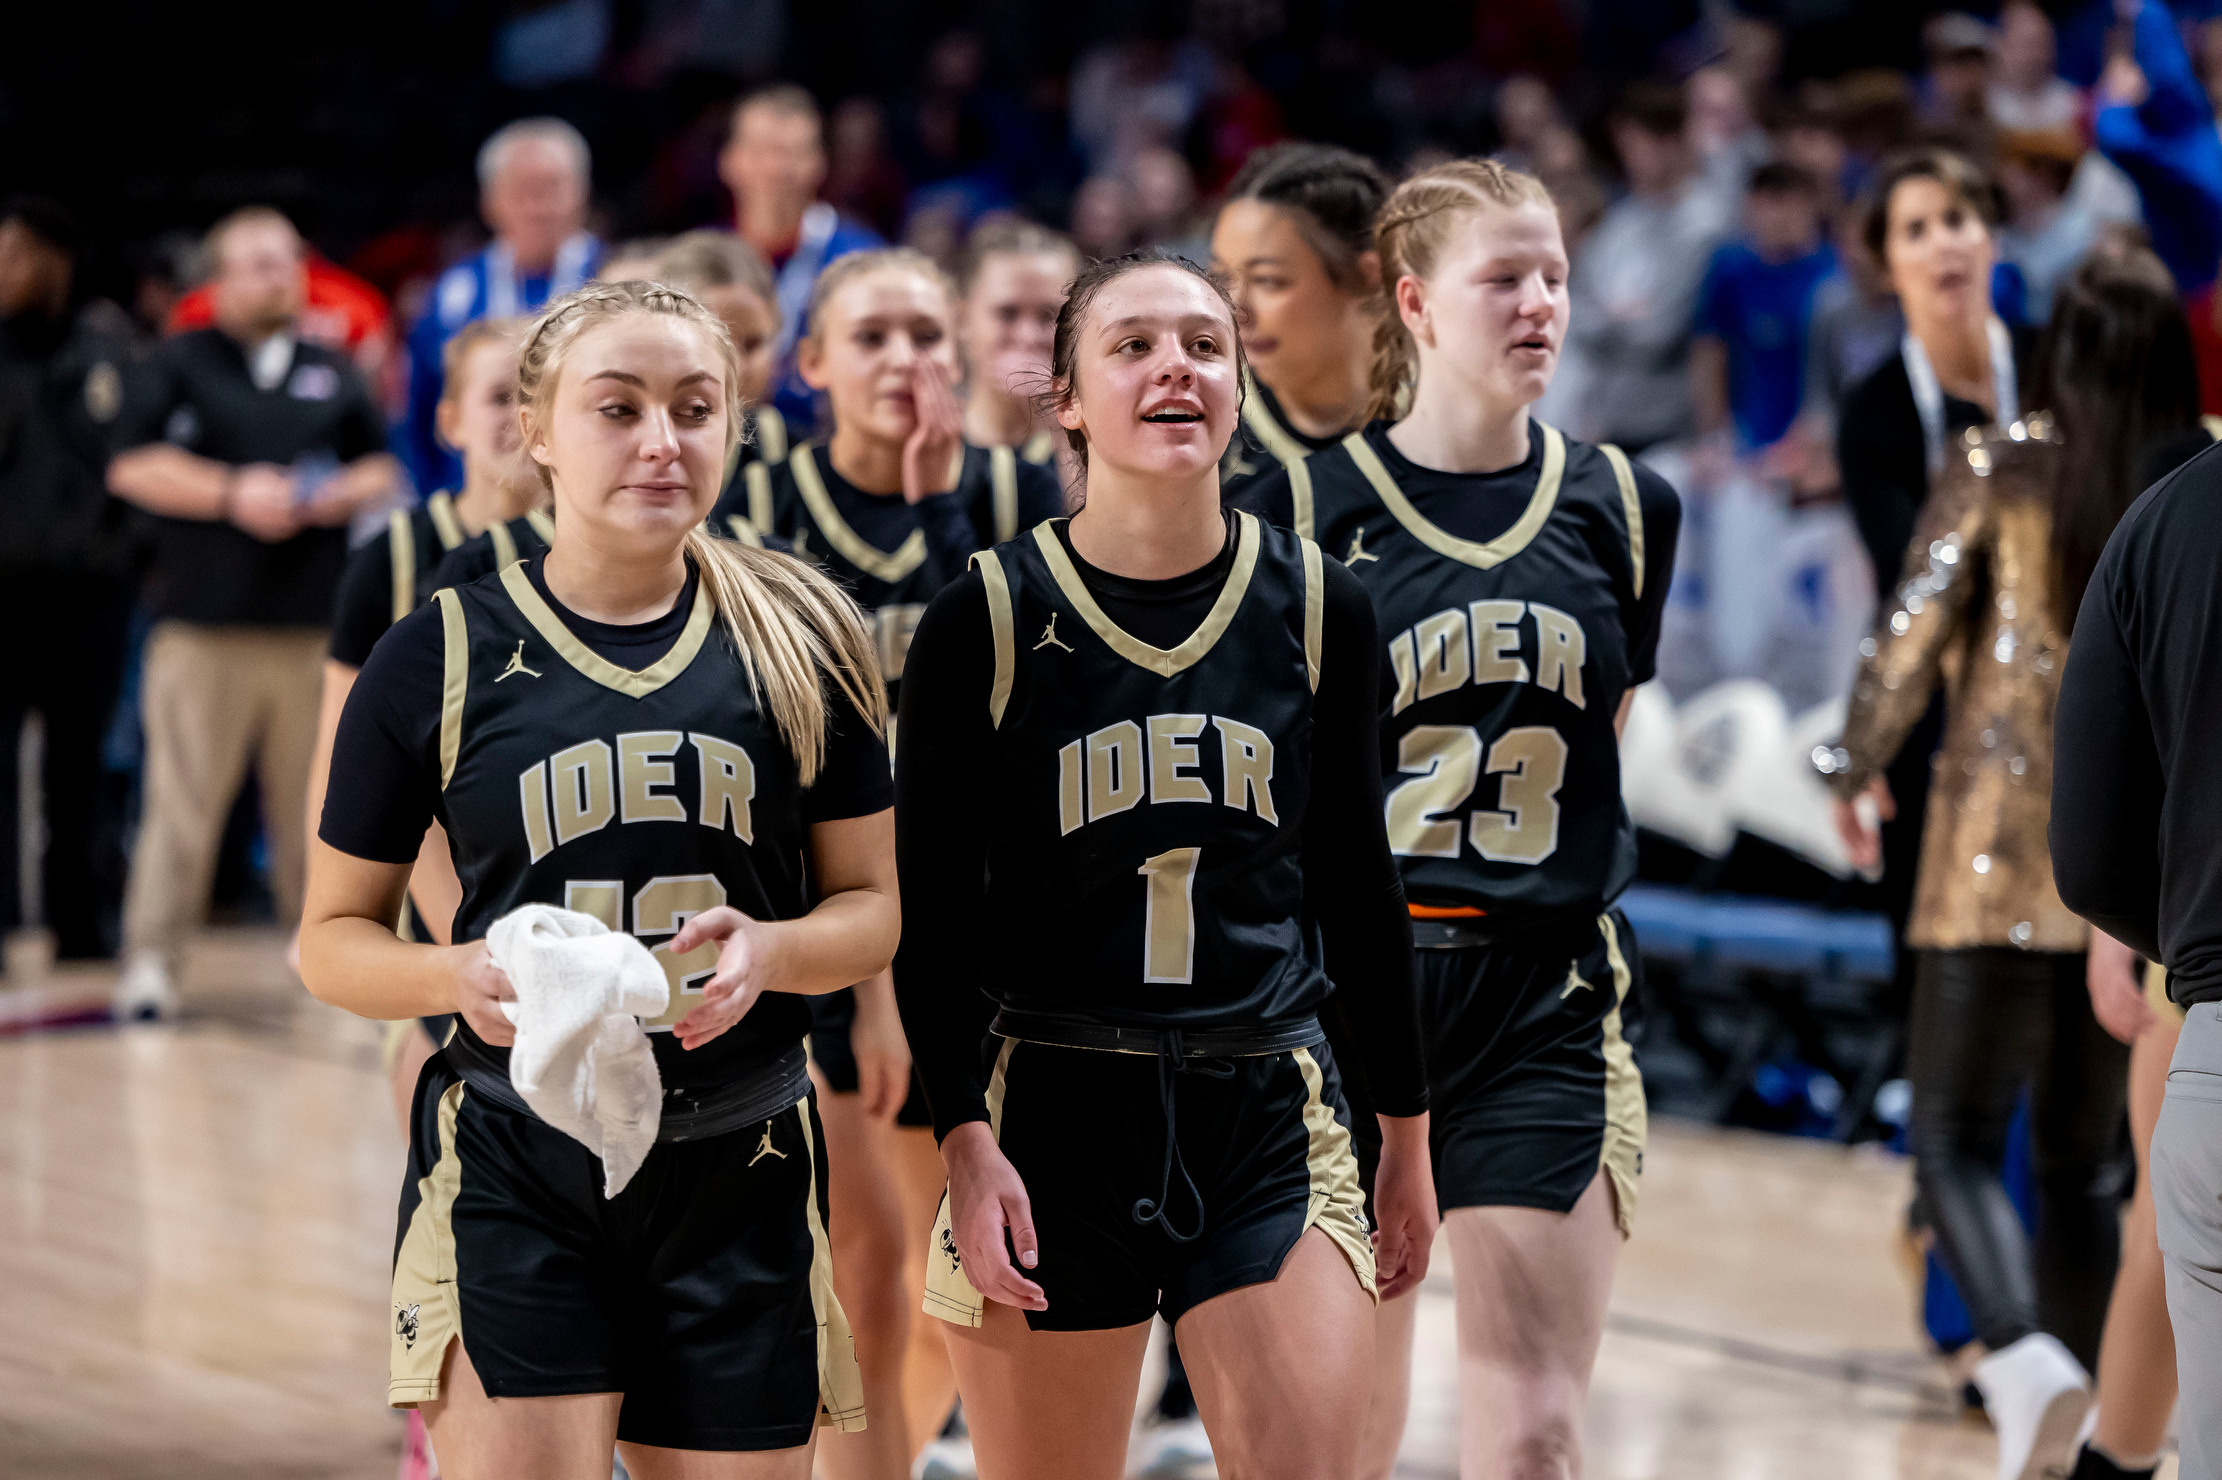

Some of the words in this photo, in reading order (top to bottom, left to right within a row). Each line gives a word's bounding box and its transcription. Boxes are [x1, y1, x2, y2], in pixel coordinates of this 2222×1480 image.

[1388, 599, 1587, 717] IDER
[519, 730, 756, 866] IDER
[1059, 713, 1279, 837] IDER
[1384, 724, 1569, 866] 23
[1137, 847, 1202, 985] 1
